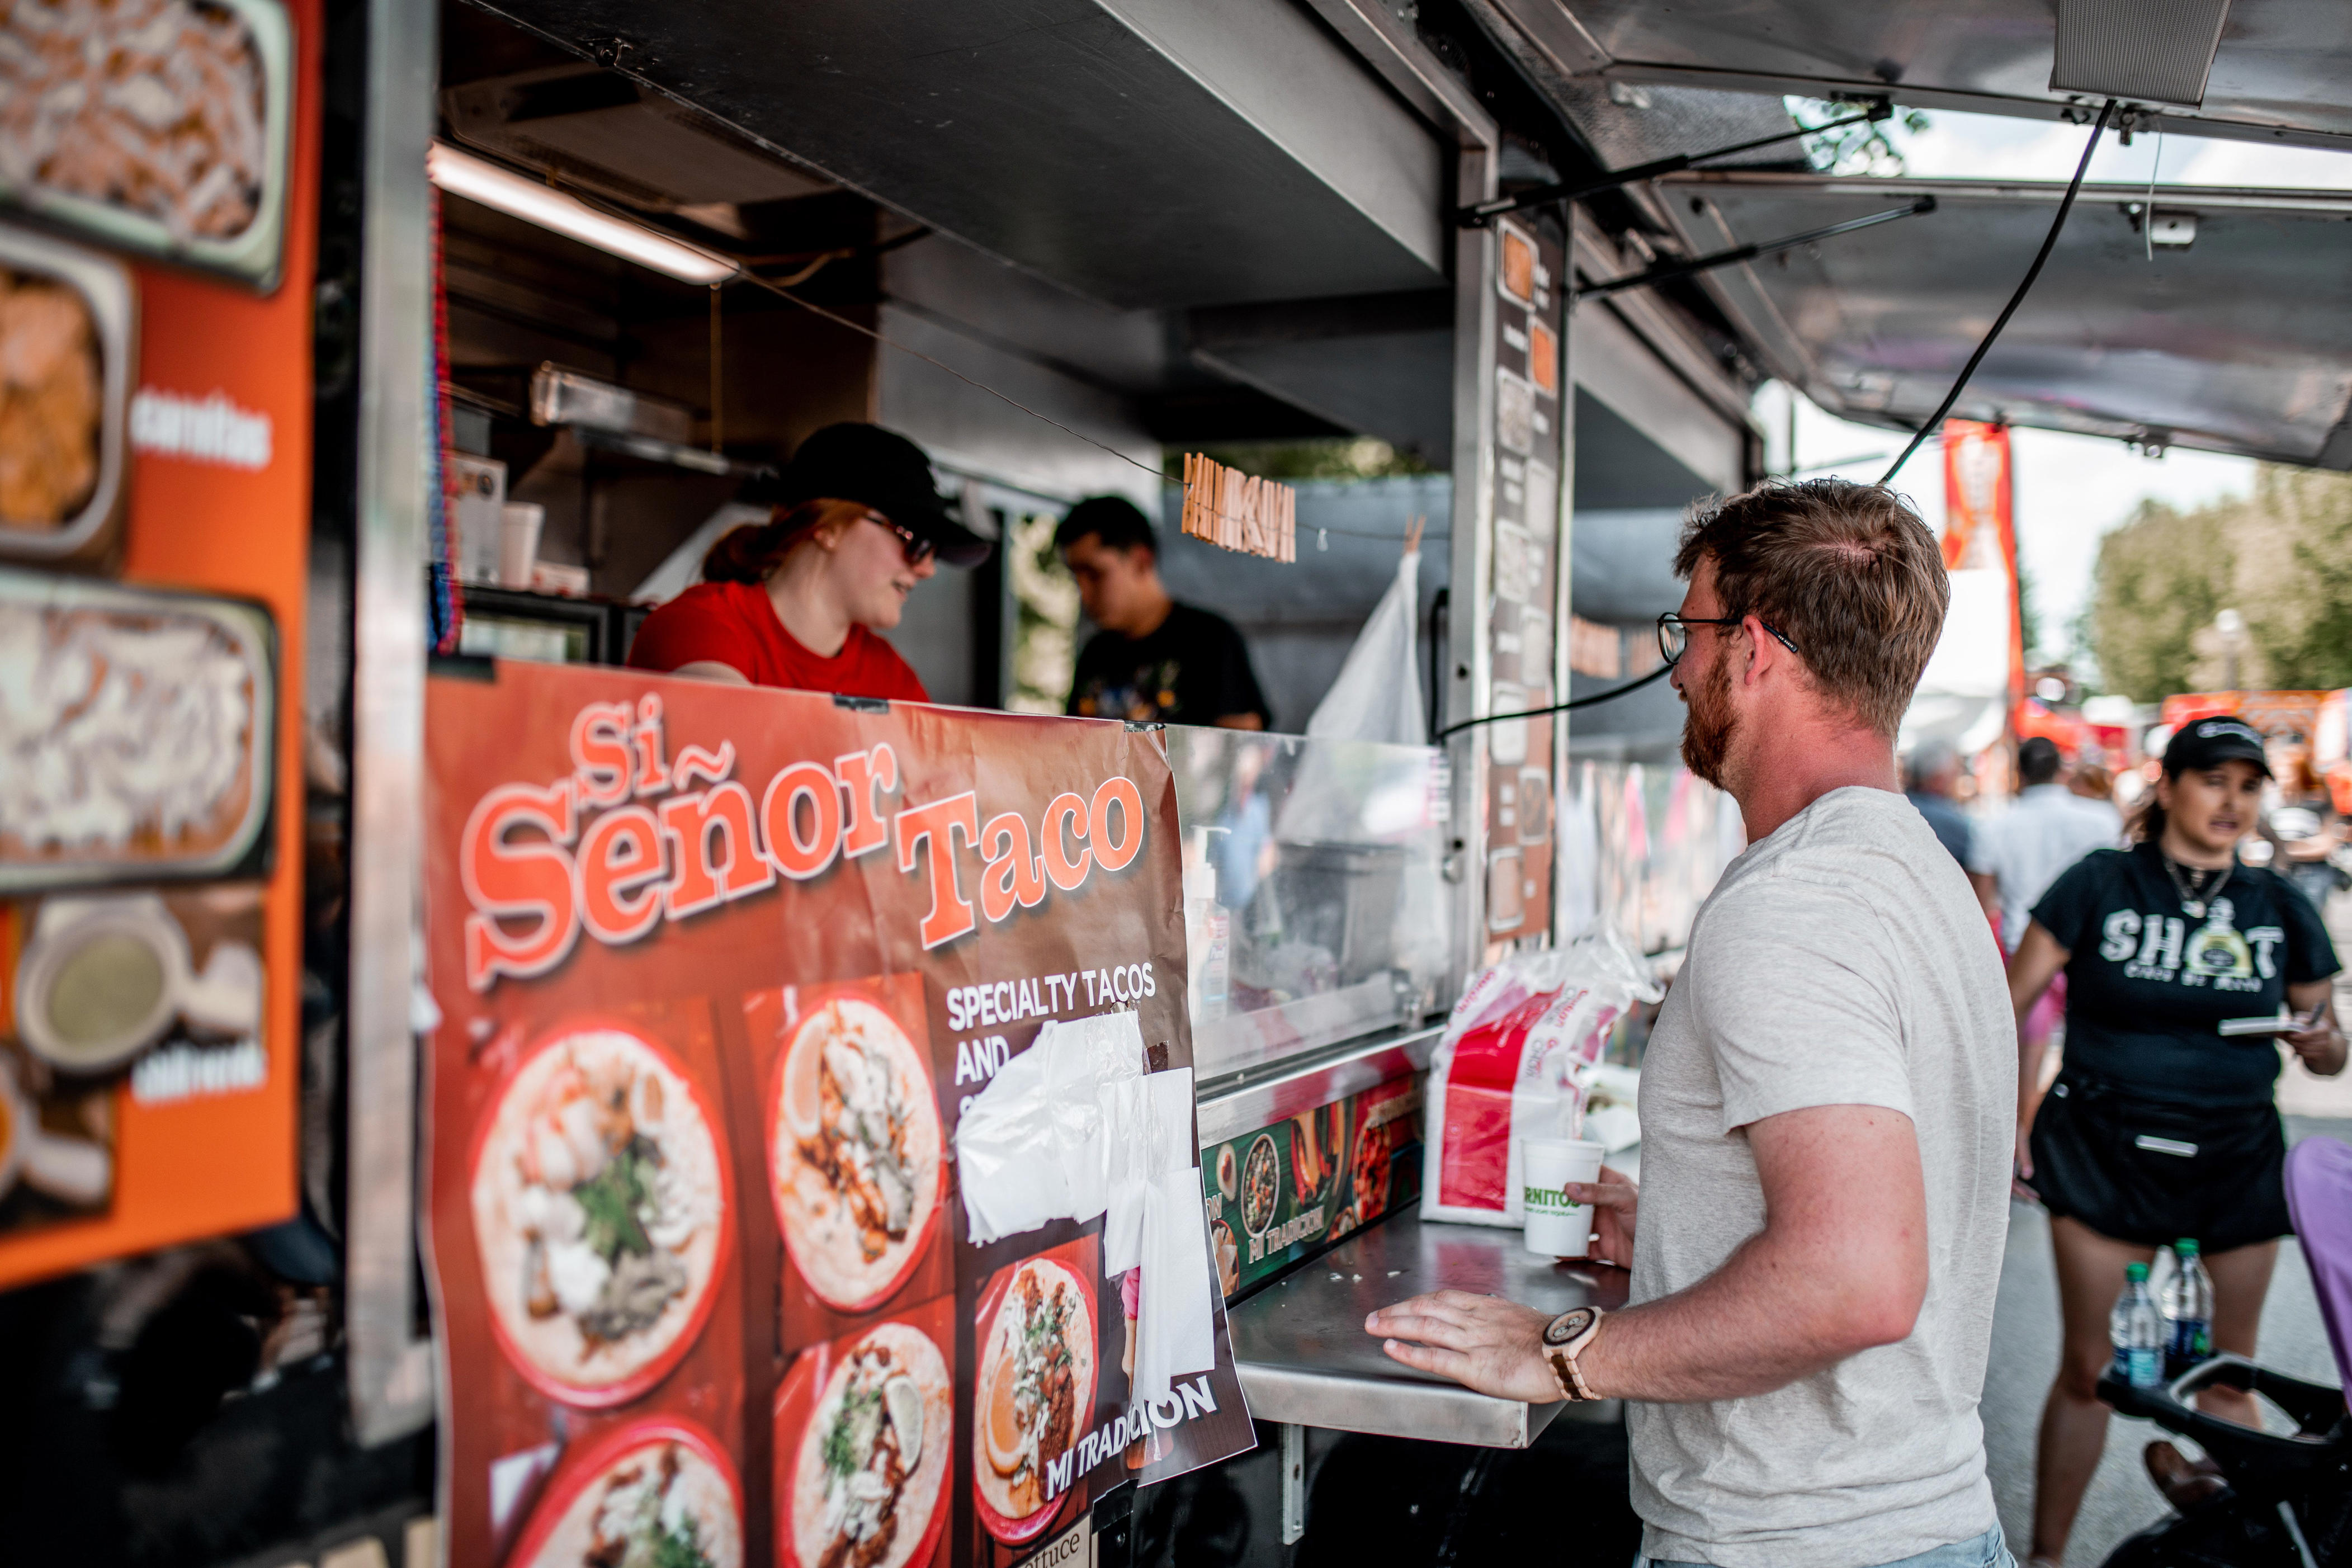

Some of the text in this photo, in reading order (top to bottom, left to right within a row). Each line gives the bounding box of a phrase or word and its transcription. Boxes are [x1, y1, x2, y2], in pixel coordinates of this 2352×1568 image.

[569, 692, 671, 813] Si
[460, 740, 1144, 991] Señor Taco
[946, 962, 1156, 1031] SPECIALTY TACOS
[955, 1035, 1010, 1086] AND
[1248, 1234, 1265, 1264] MI
[1265, 1205, 1325, 1255] TRADICION
[1046, 1447, 1074, 1501] MI
